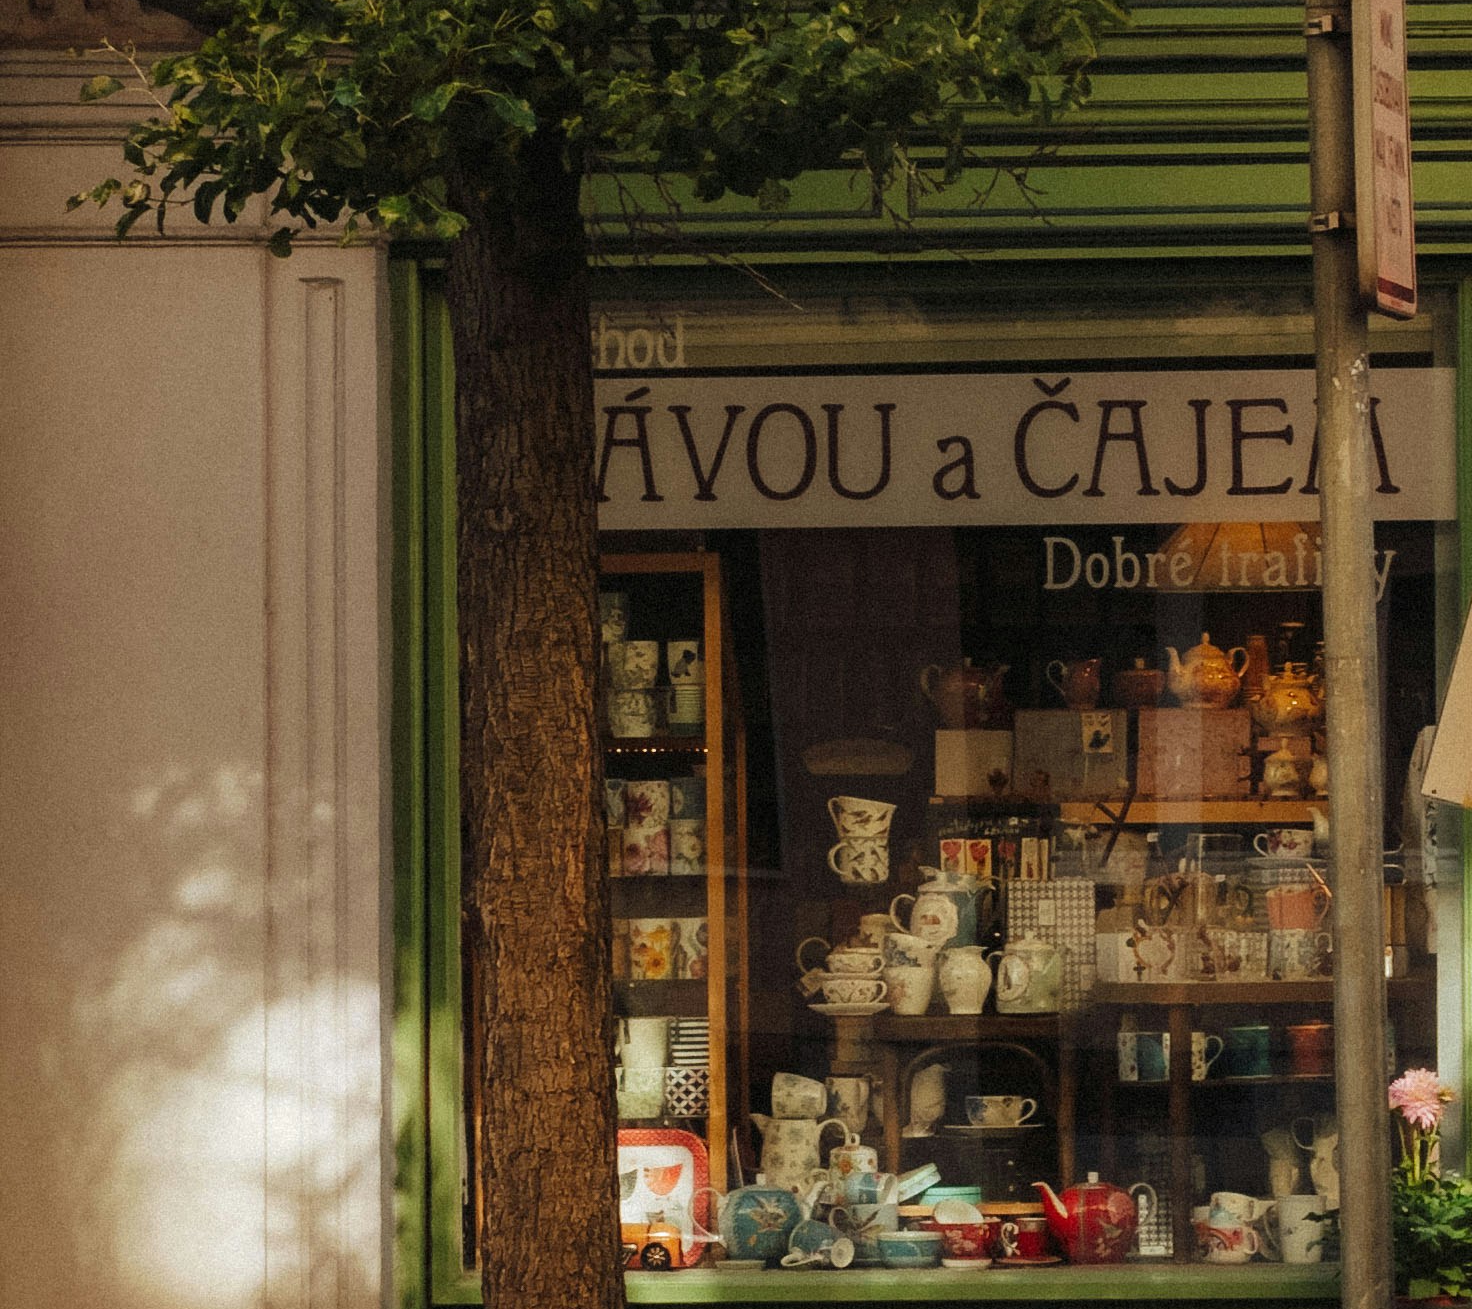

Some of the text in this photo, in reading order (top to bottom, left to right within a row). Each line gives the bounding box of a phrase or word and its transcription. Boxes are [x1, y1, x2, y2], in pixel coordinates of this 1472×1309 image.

[591, 313, 687, 369] hod
[932, 434, 981, 500] a
[1042, 532, 1399, 603] Dobré trafiy
